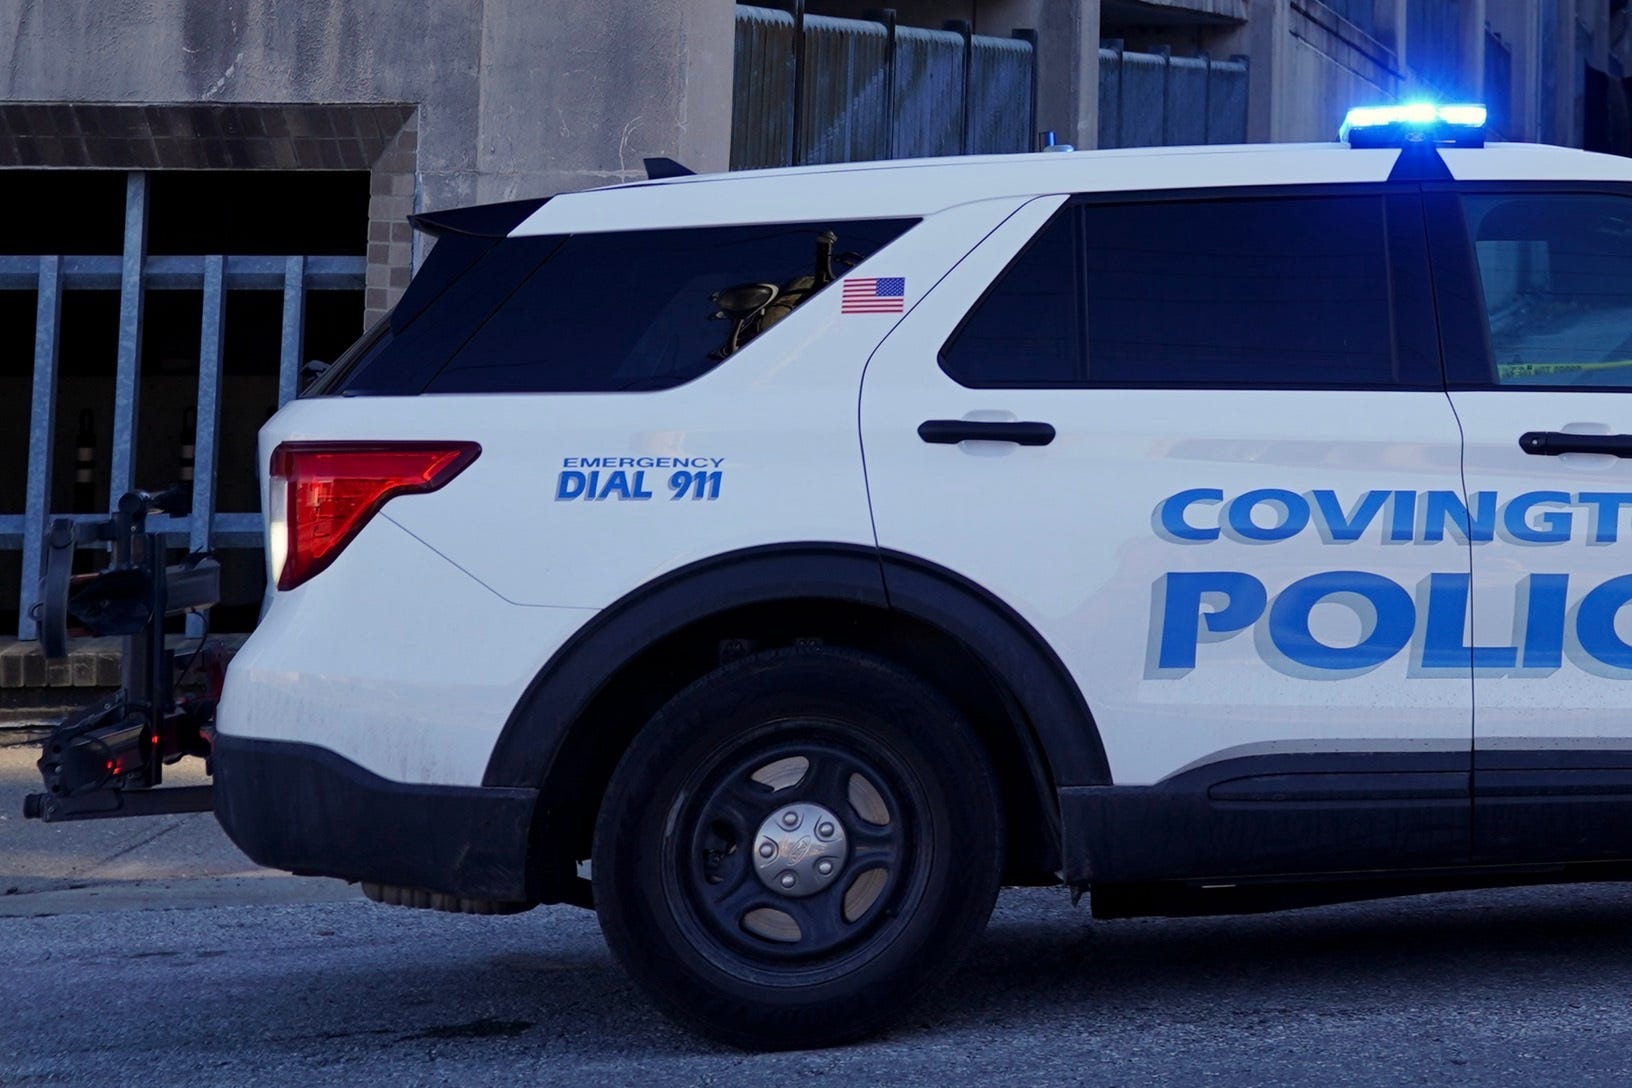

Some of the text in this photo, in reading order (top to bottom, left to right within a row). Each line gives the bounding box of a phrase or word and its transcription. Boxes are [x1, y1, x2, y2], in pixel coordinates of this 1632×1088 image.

[563, 457, 725, 468] EMERGENCY
[554, 470, 723, 502] DIAL 911
